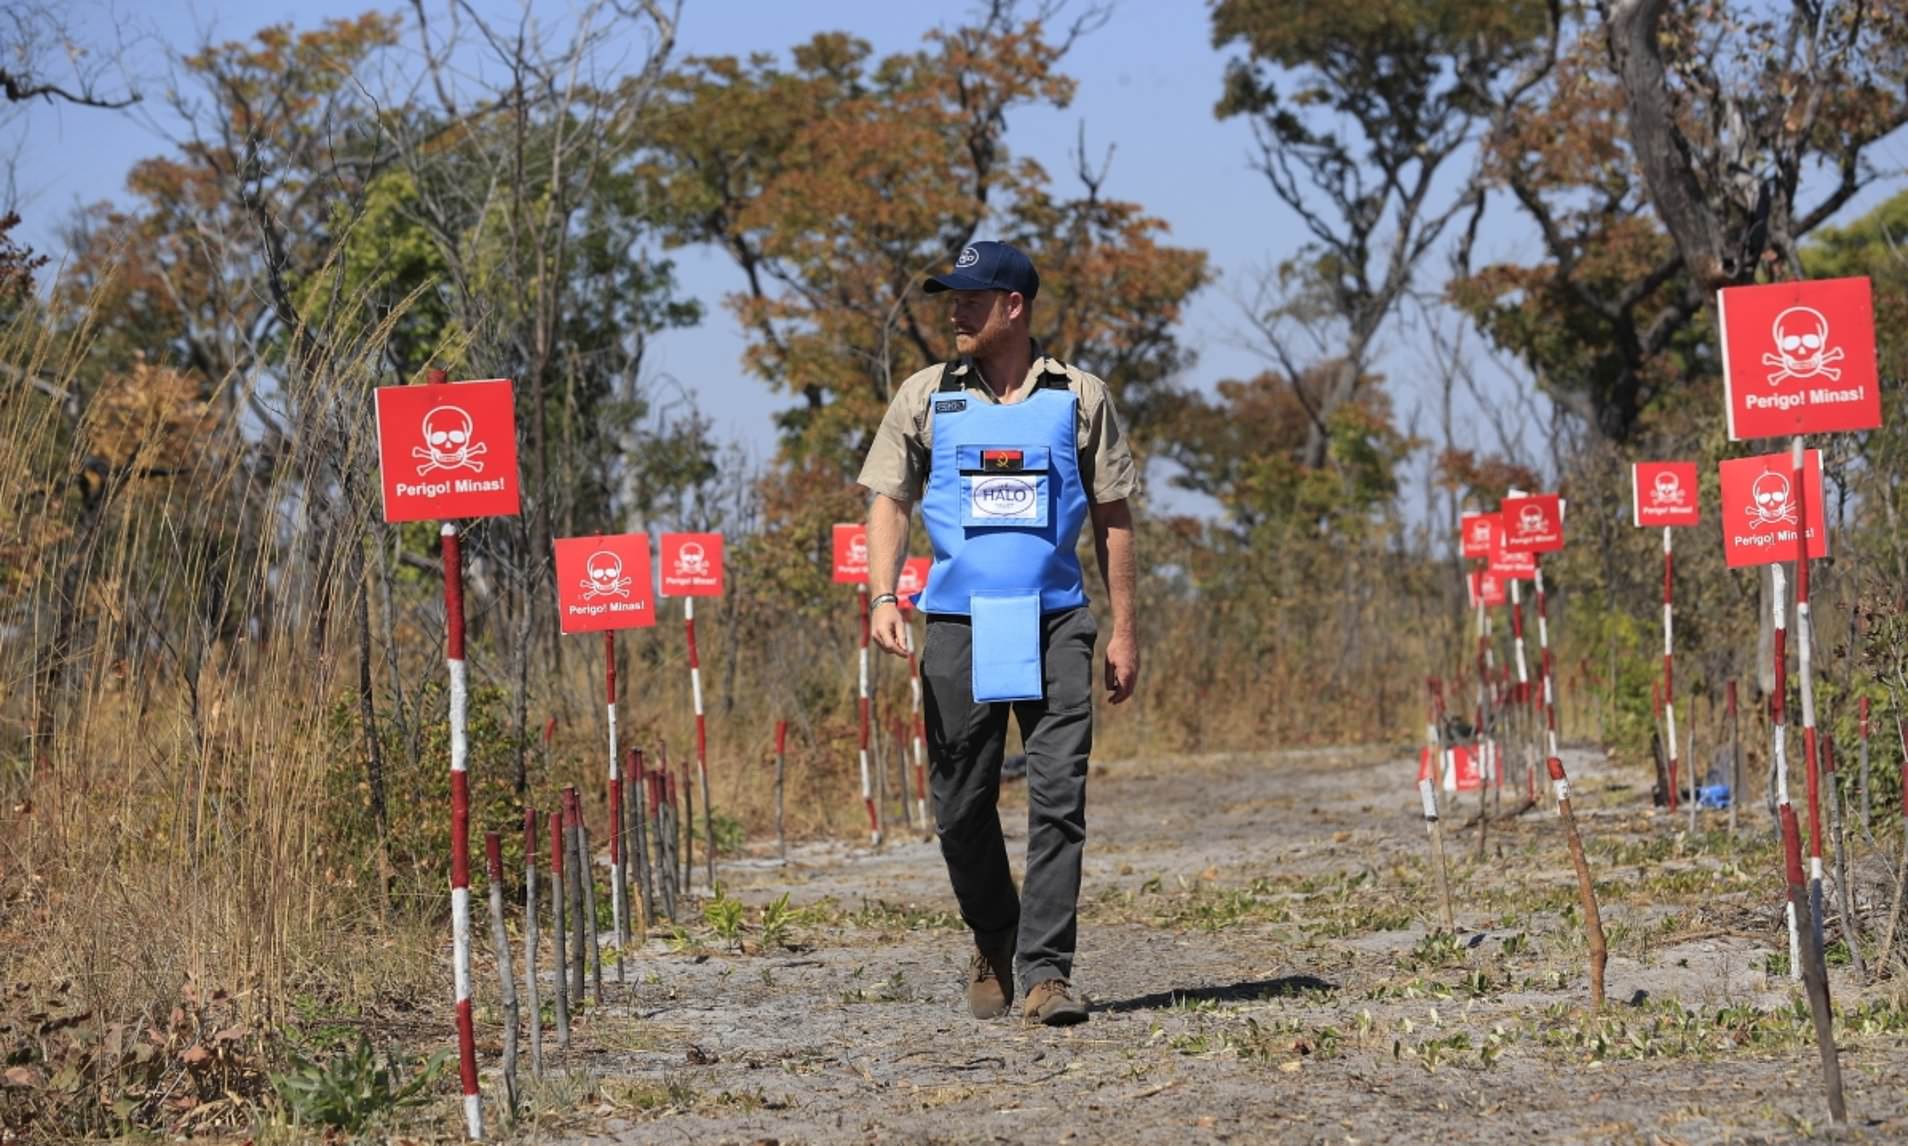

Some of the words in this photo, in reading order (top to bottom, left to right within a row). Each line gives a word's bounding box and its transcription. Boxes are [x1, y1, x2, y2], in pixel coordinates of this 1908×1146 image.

[1746, 391, 1805, 410] Perigo!
[1810, 385, 1864, 404] Minas!
[396, 480, 451, 498] Perigo!
[455, 477, 504, 493] Minas!
[983, 488, 1026, 502] HALO
[1735, 532, 1775, 546] Perigo!
[1777, 527, 1815, 541] Mins!
[569, 604, 608, 616] Perigo!
[609, 600, 645, 612] Minas!
